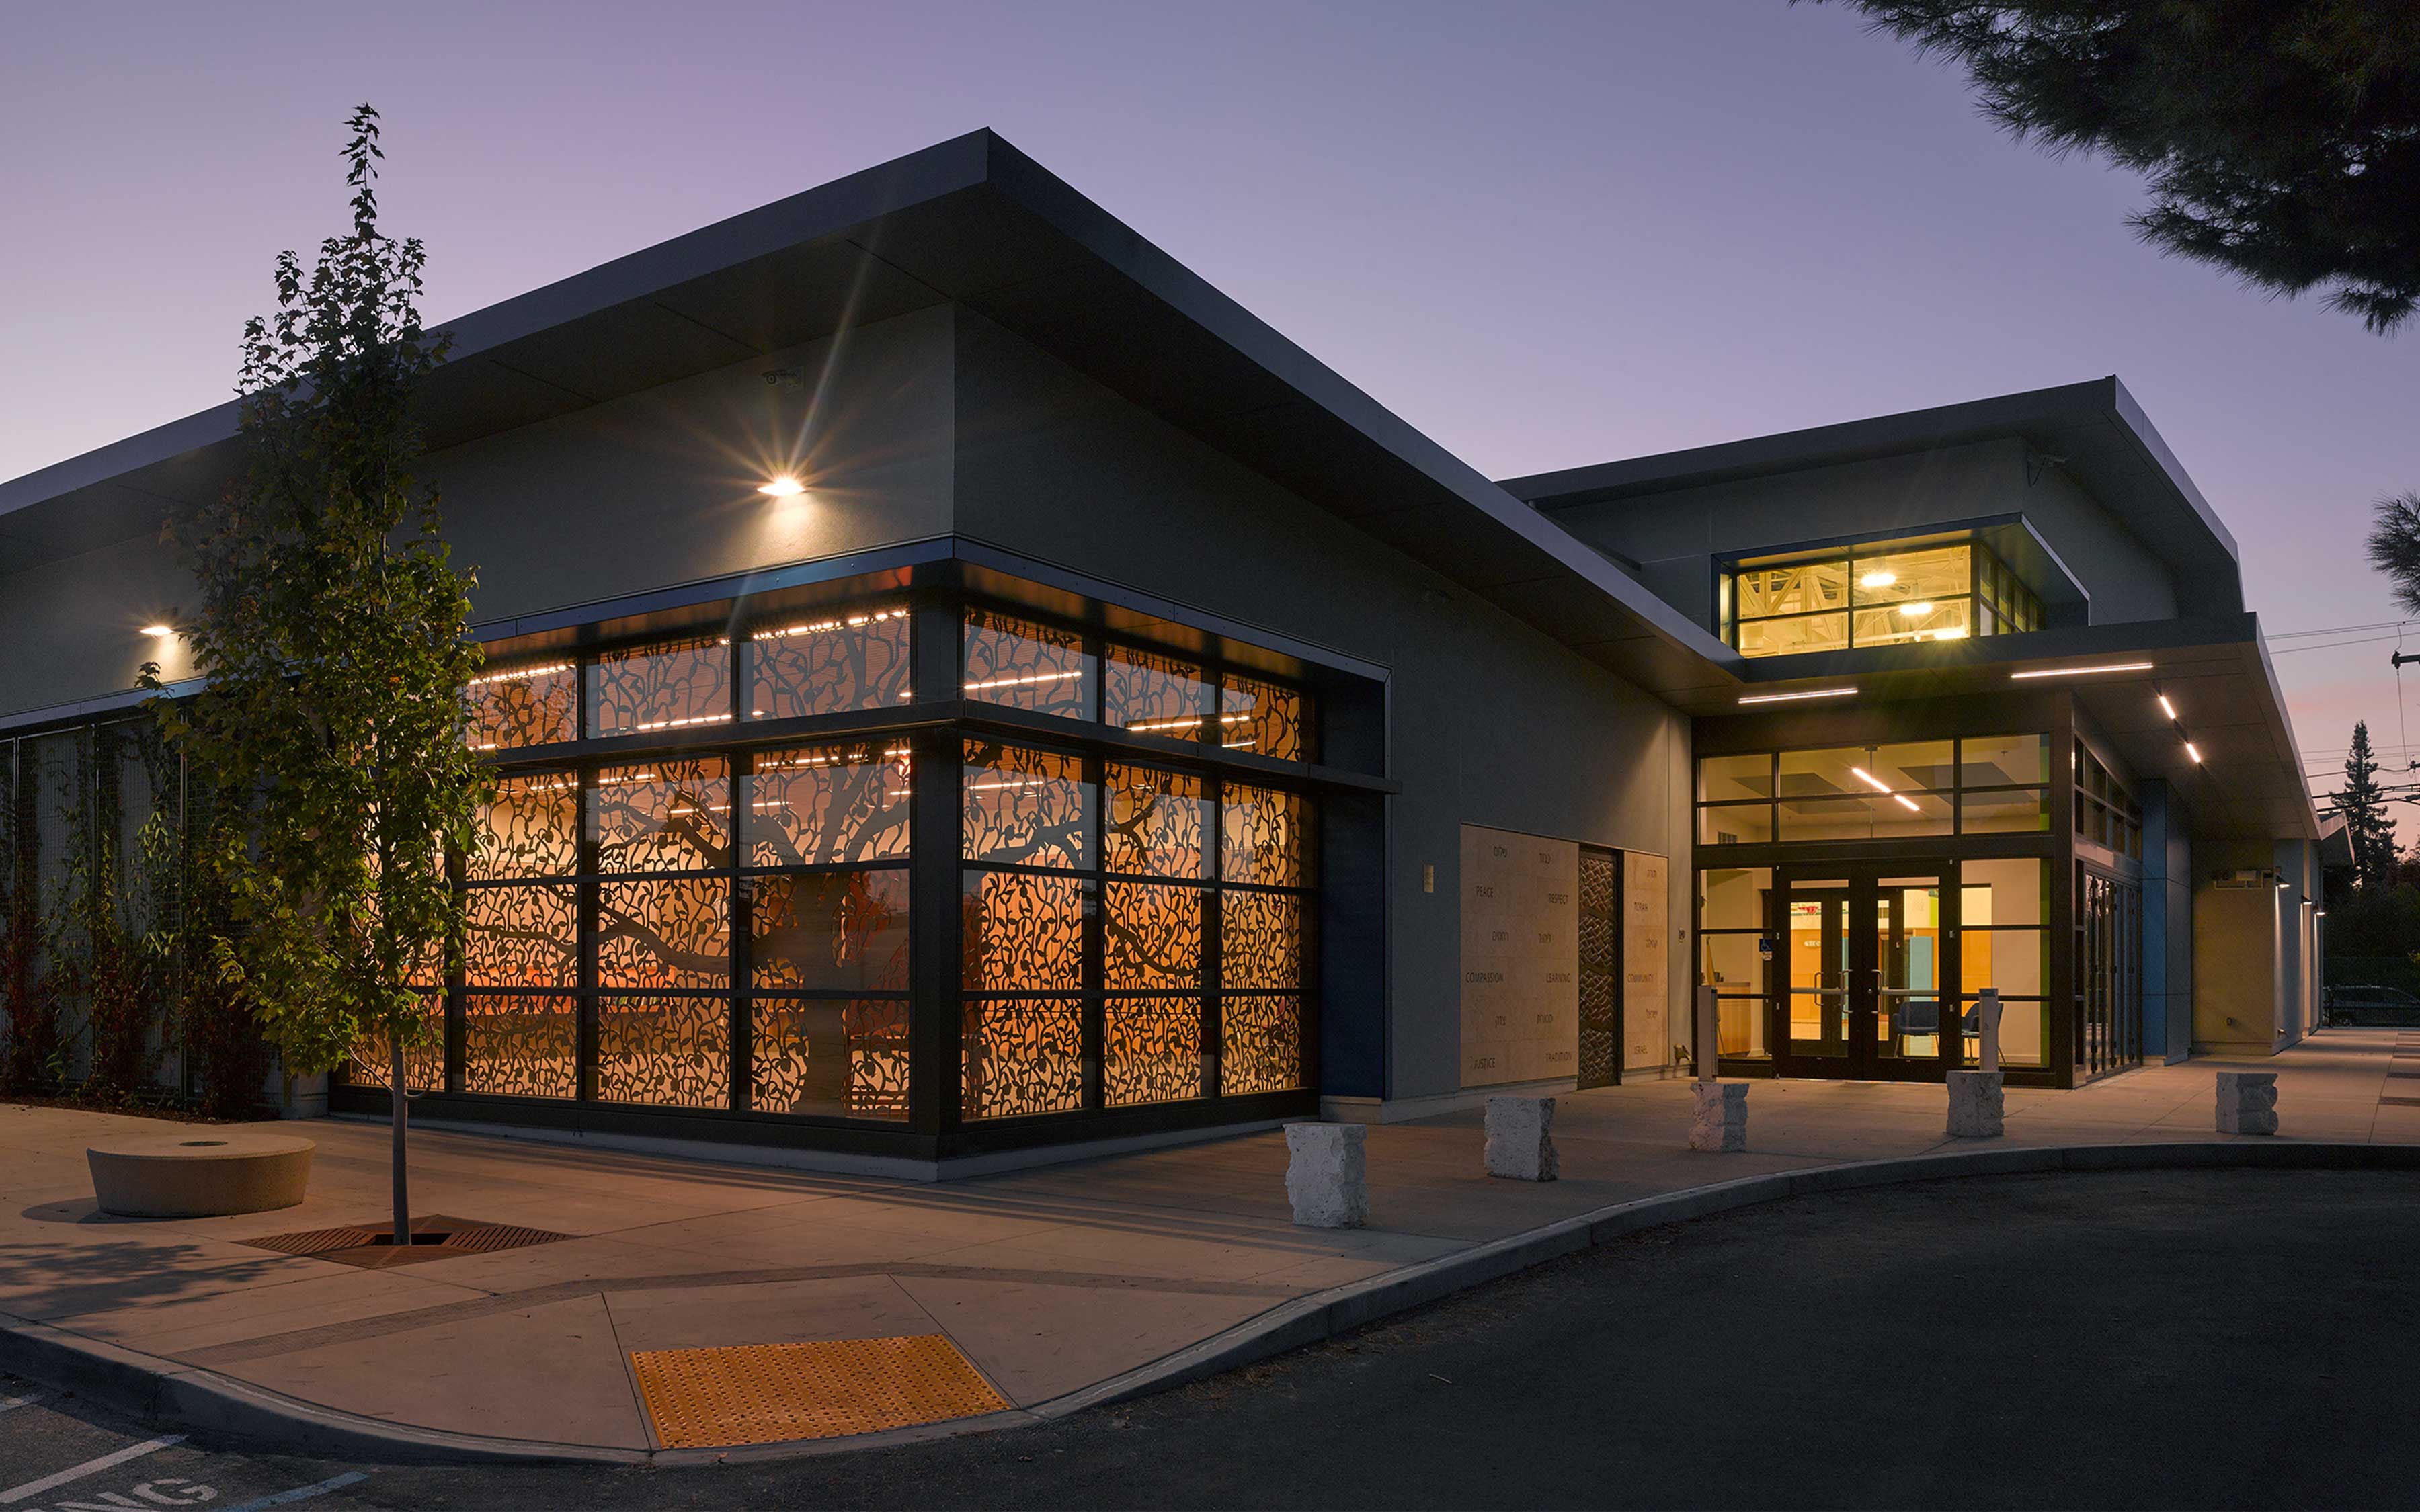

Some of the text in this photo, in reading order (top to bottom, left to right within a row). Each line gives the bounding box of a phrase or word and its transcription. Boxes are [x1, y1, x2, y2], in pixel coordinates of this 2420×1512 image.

[1476, 886, 1494, 898] PEACE
[1547, 893, 1569, 905] RESPECT
[1465, 972, 1504, 983] COMPASSION
[1545, 972, 1571, 983] LEARNING
[1627, 974, 1654, 983] COMMUNITY
[1545, 1051, 1572, 1062] TRADITION
[1474, 1057, 1496, 1070] JUSTICE
